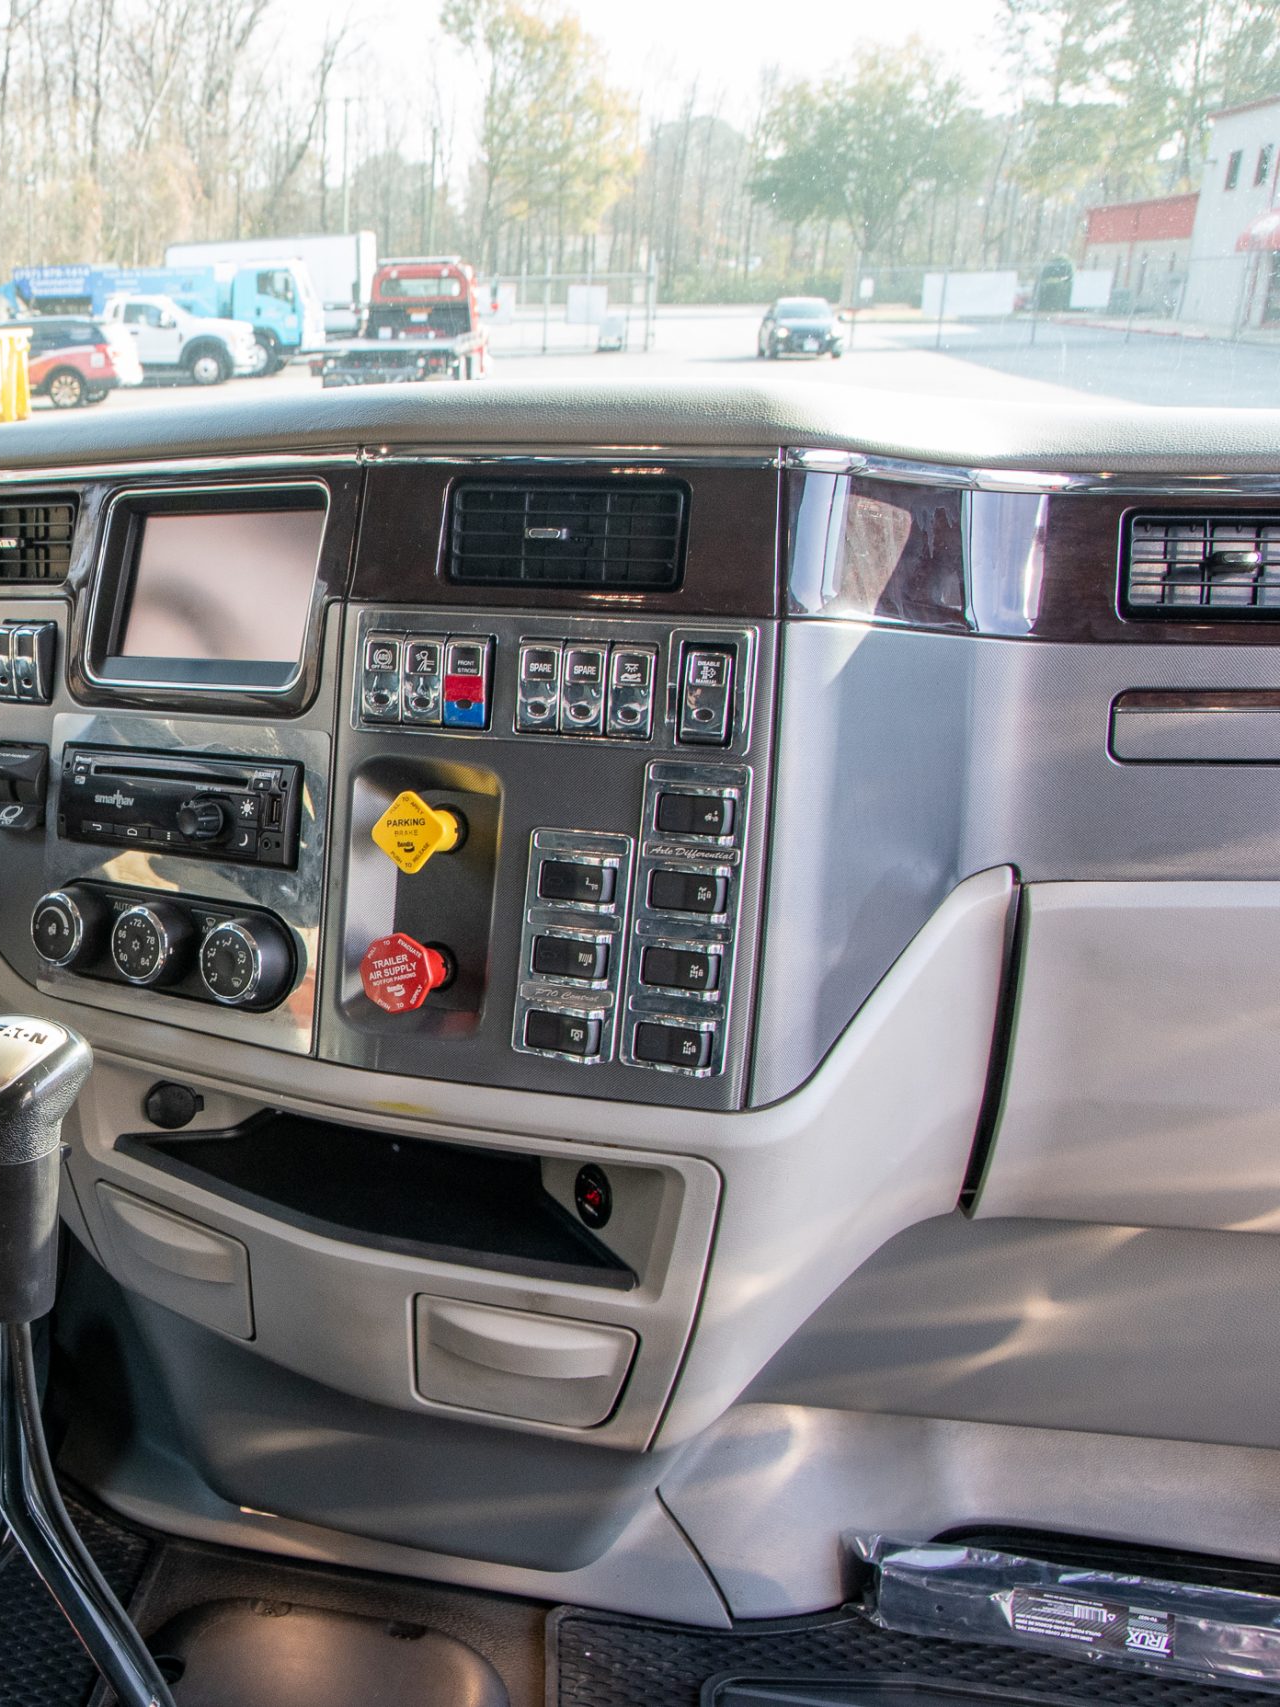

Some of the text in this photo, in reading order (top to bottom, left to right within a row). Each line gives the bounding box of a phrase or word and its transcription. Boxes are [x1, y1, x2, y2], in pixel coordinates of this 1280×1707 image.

[529, 663, 552, 673] SPARE
[573, 666, 596, 675] SPARE
[410, 802, 424, 814] APPLY
[387, 818, 425, 828] PARKING
[390, 851, 402, 863] PUSH
[412, 842, 430, 862] RELEASE
[650, 846, 734, 860] Axle Differential
[114, 902, 133, 911] AUTO
[133, 919, 142, 927] 72
[146, 936, 155, 944] 78
[398, 939, 422, 959] EVACUATE
[141, 958, 150, 966] 84
[372, 954, 408, 969] TRAILER
[369, 962, 417, 981] AIR SUPPLY
[394, 972, 416, 981] PARKING
[376, 998, 391, 1010] PUSH
[410, 984, 422, 1004] SUPPLY
[535, 988, 599, 1001] PTO Control
[1125, 1630, 1171, 1653] TRUX
